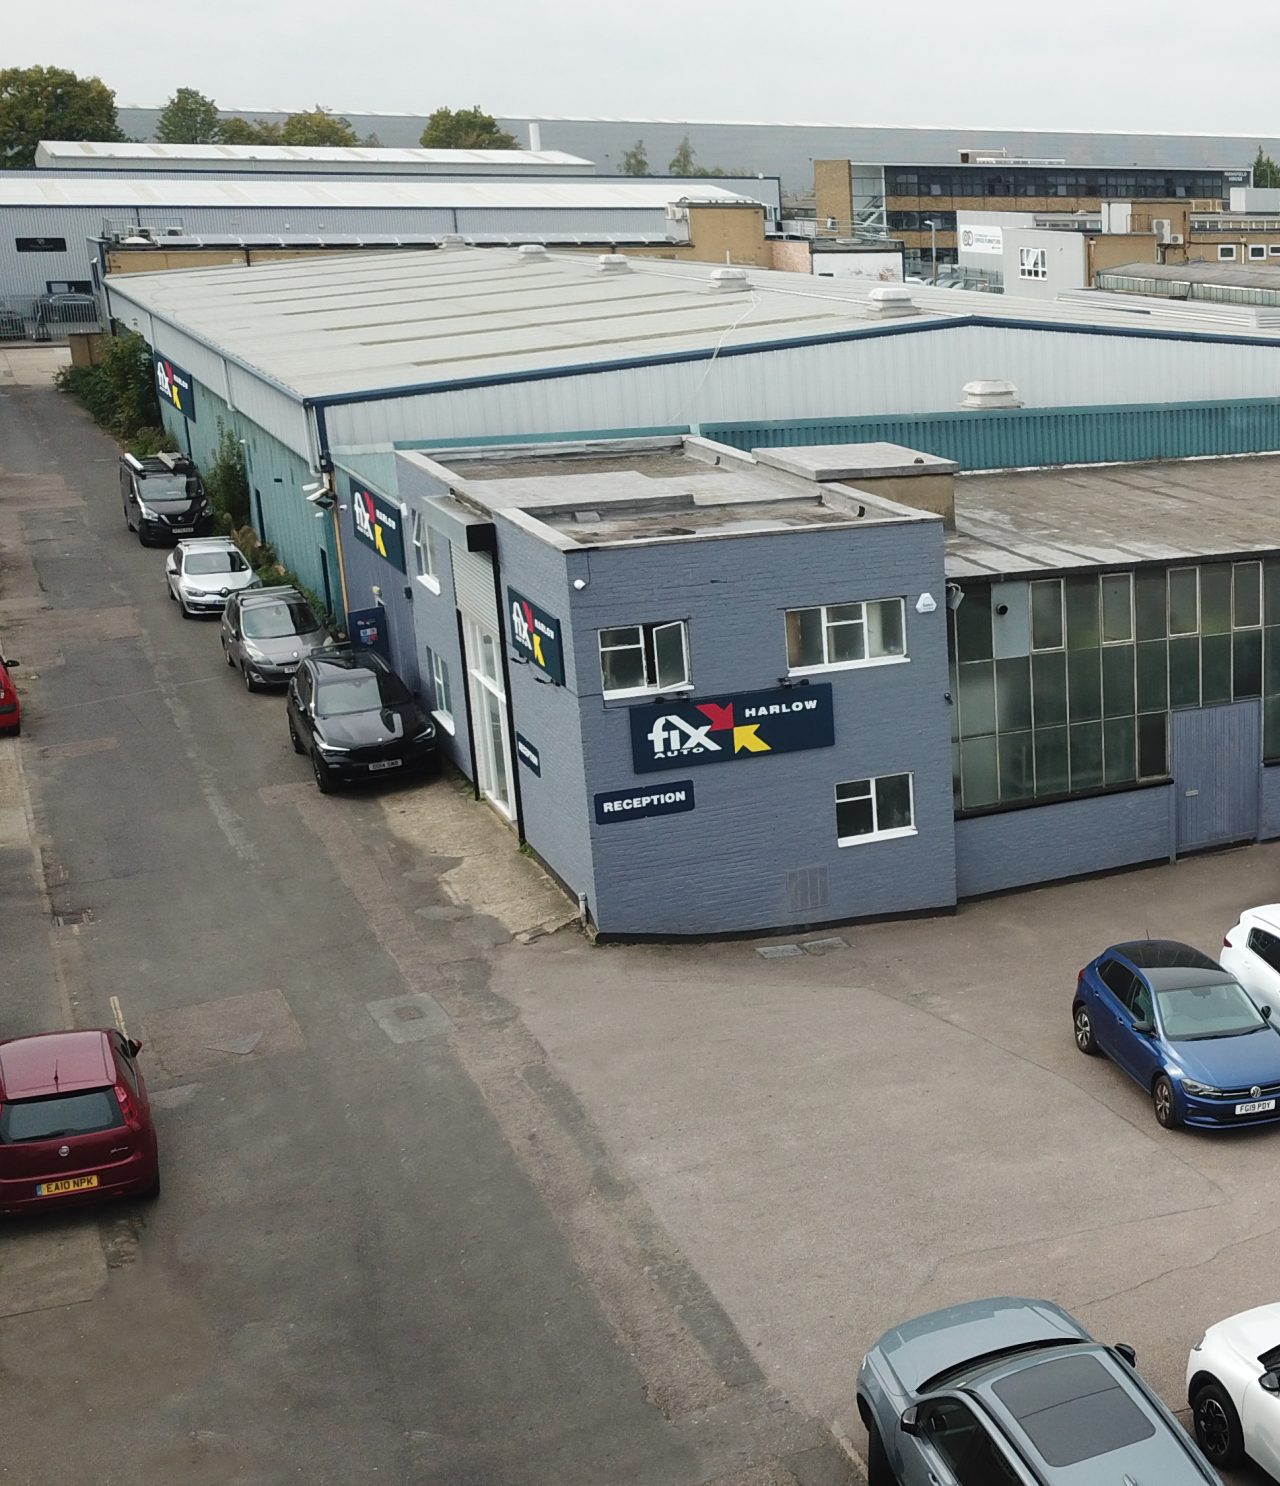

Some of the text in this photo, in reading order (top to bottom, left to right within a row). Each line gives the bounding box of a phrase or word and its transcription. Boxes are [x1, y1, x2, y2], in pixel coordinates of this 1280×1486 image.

[744, 699, 818, 718] HARLOW
[654, 747, 705, 760] AUTO
[603, 790, 686, 813] RECEPTION
[1239, 1103, 1256, 1113] FG19
[46, 1176, 94, 1193] EA10 NPK
